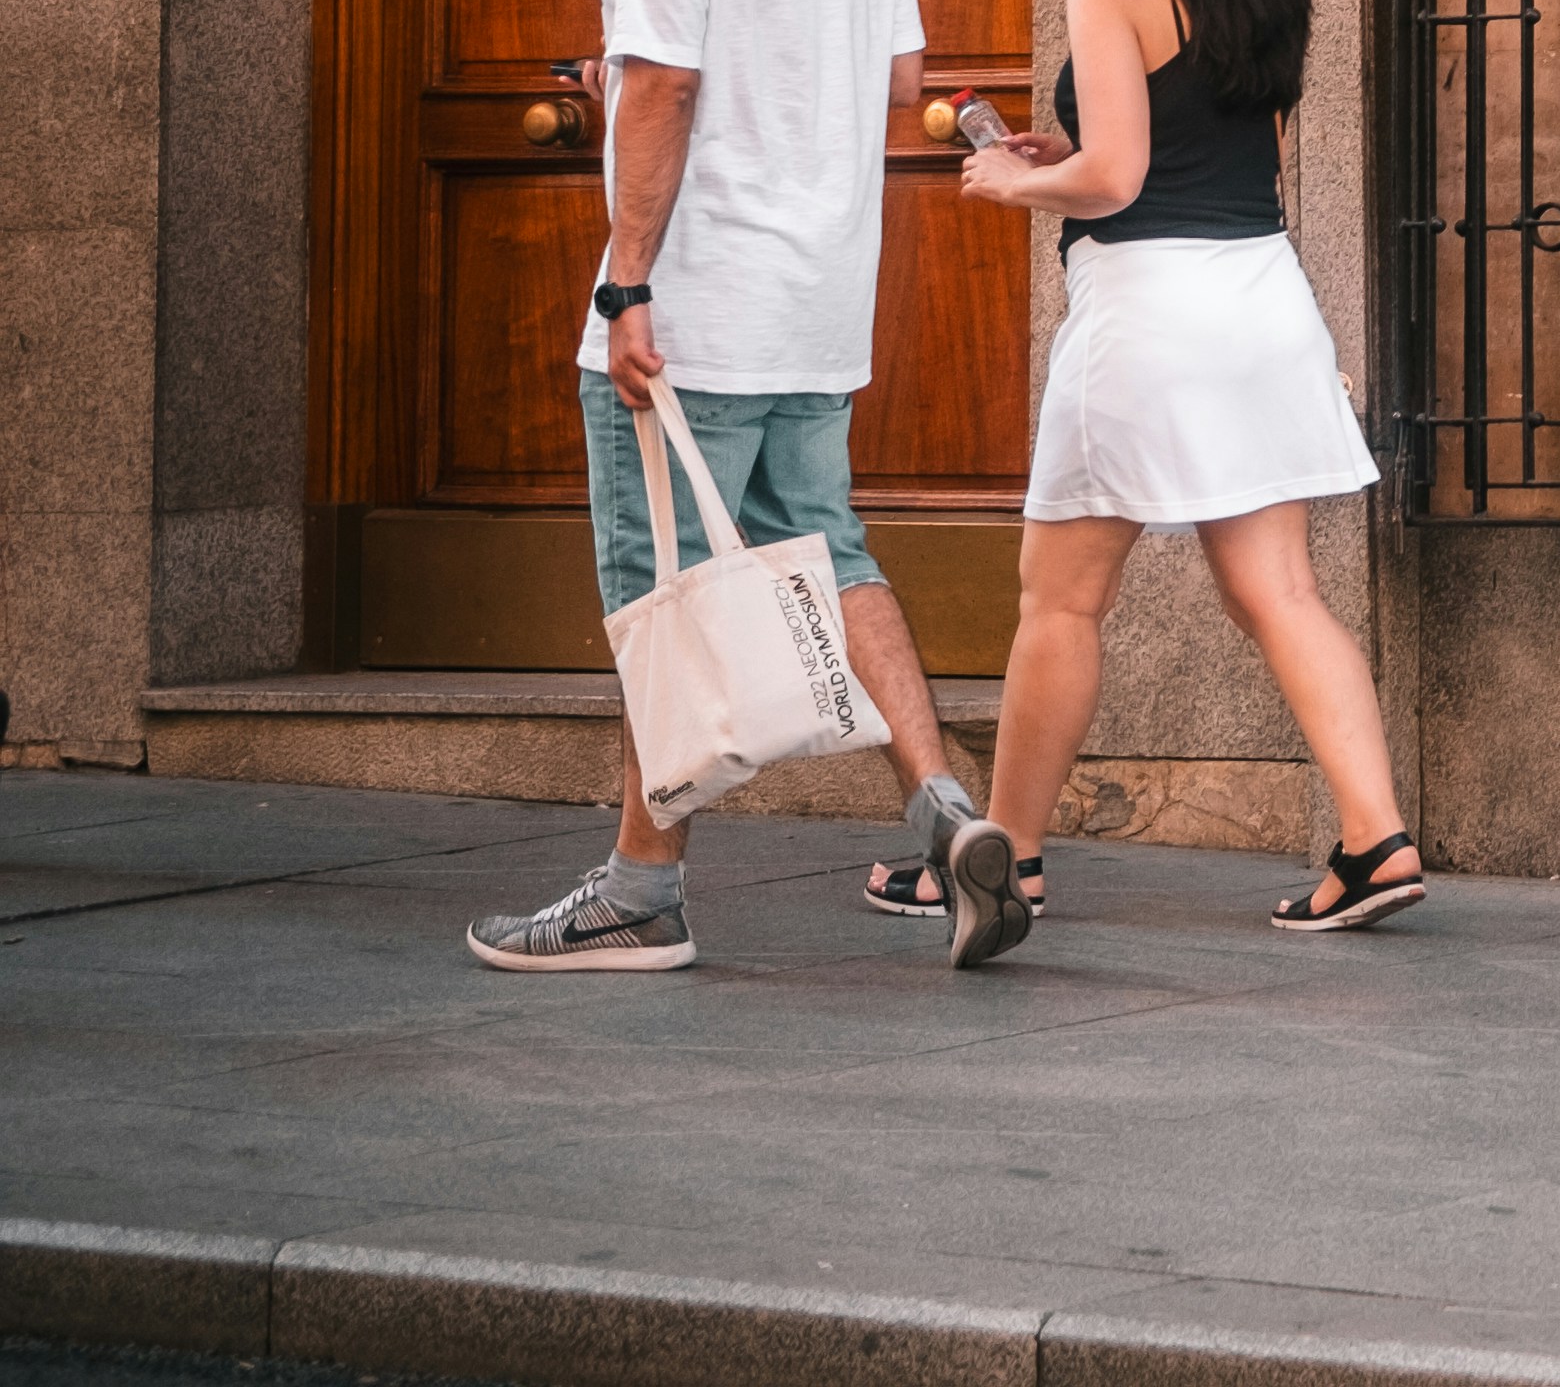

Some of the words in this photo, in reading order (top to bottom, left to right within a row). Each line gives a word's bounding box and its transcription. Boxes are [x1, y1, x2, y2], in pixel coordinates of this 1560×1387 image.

[770, 578, 822, 678] NEOBIOTECH
[788, 572, 840, 670] SYMPOSIUM
[810, 679, 833, 719] 2022
[830, 672, 857, 739] WORLD
